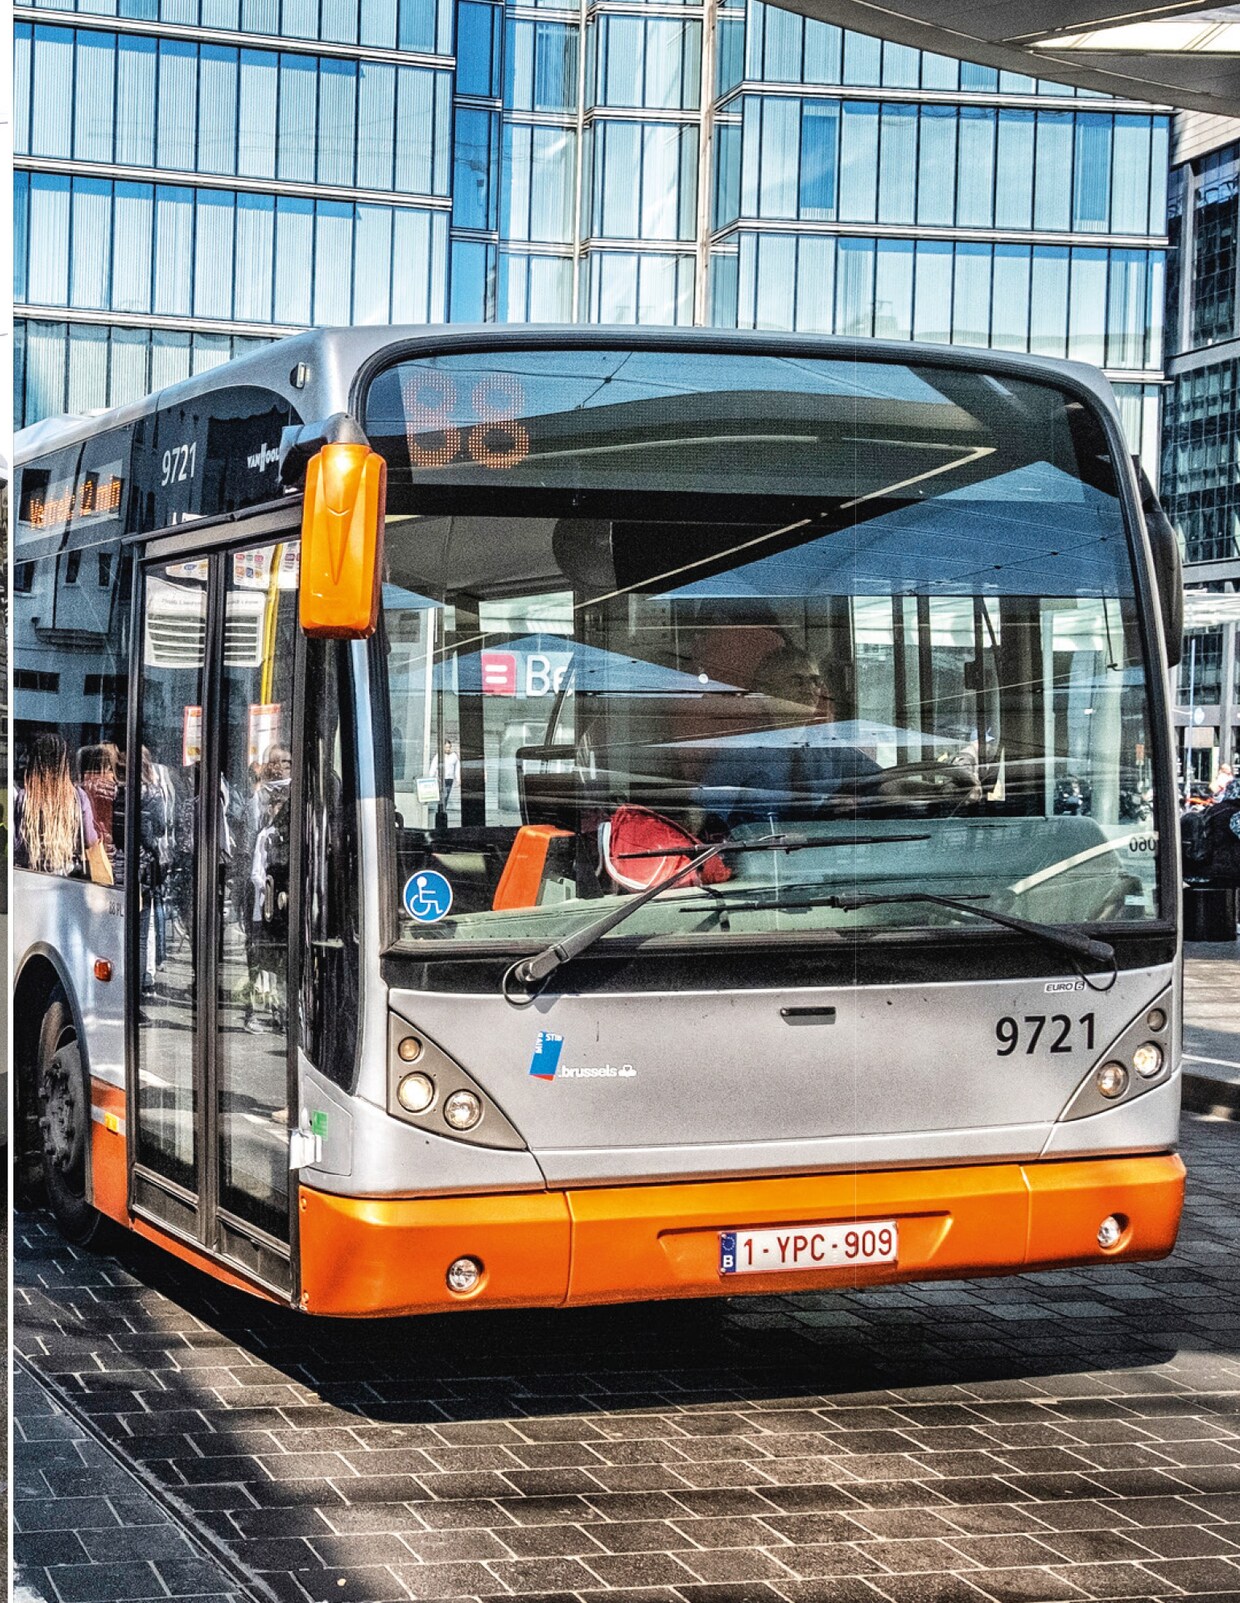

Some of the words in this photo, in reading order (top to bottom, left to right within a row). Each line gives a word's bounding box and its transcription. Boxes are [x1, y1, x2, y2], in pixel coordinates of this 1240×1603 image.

[403, 371, 529, 469] 88
[161, 441, 197, 487] 9721
[1046, 983, 1073, 991] EURO
[996, 1012, 1094, 1056] 9721
[723, 1255, 734, 1268] B
[744, 1228, 892, 1265] 1-YPC-909
